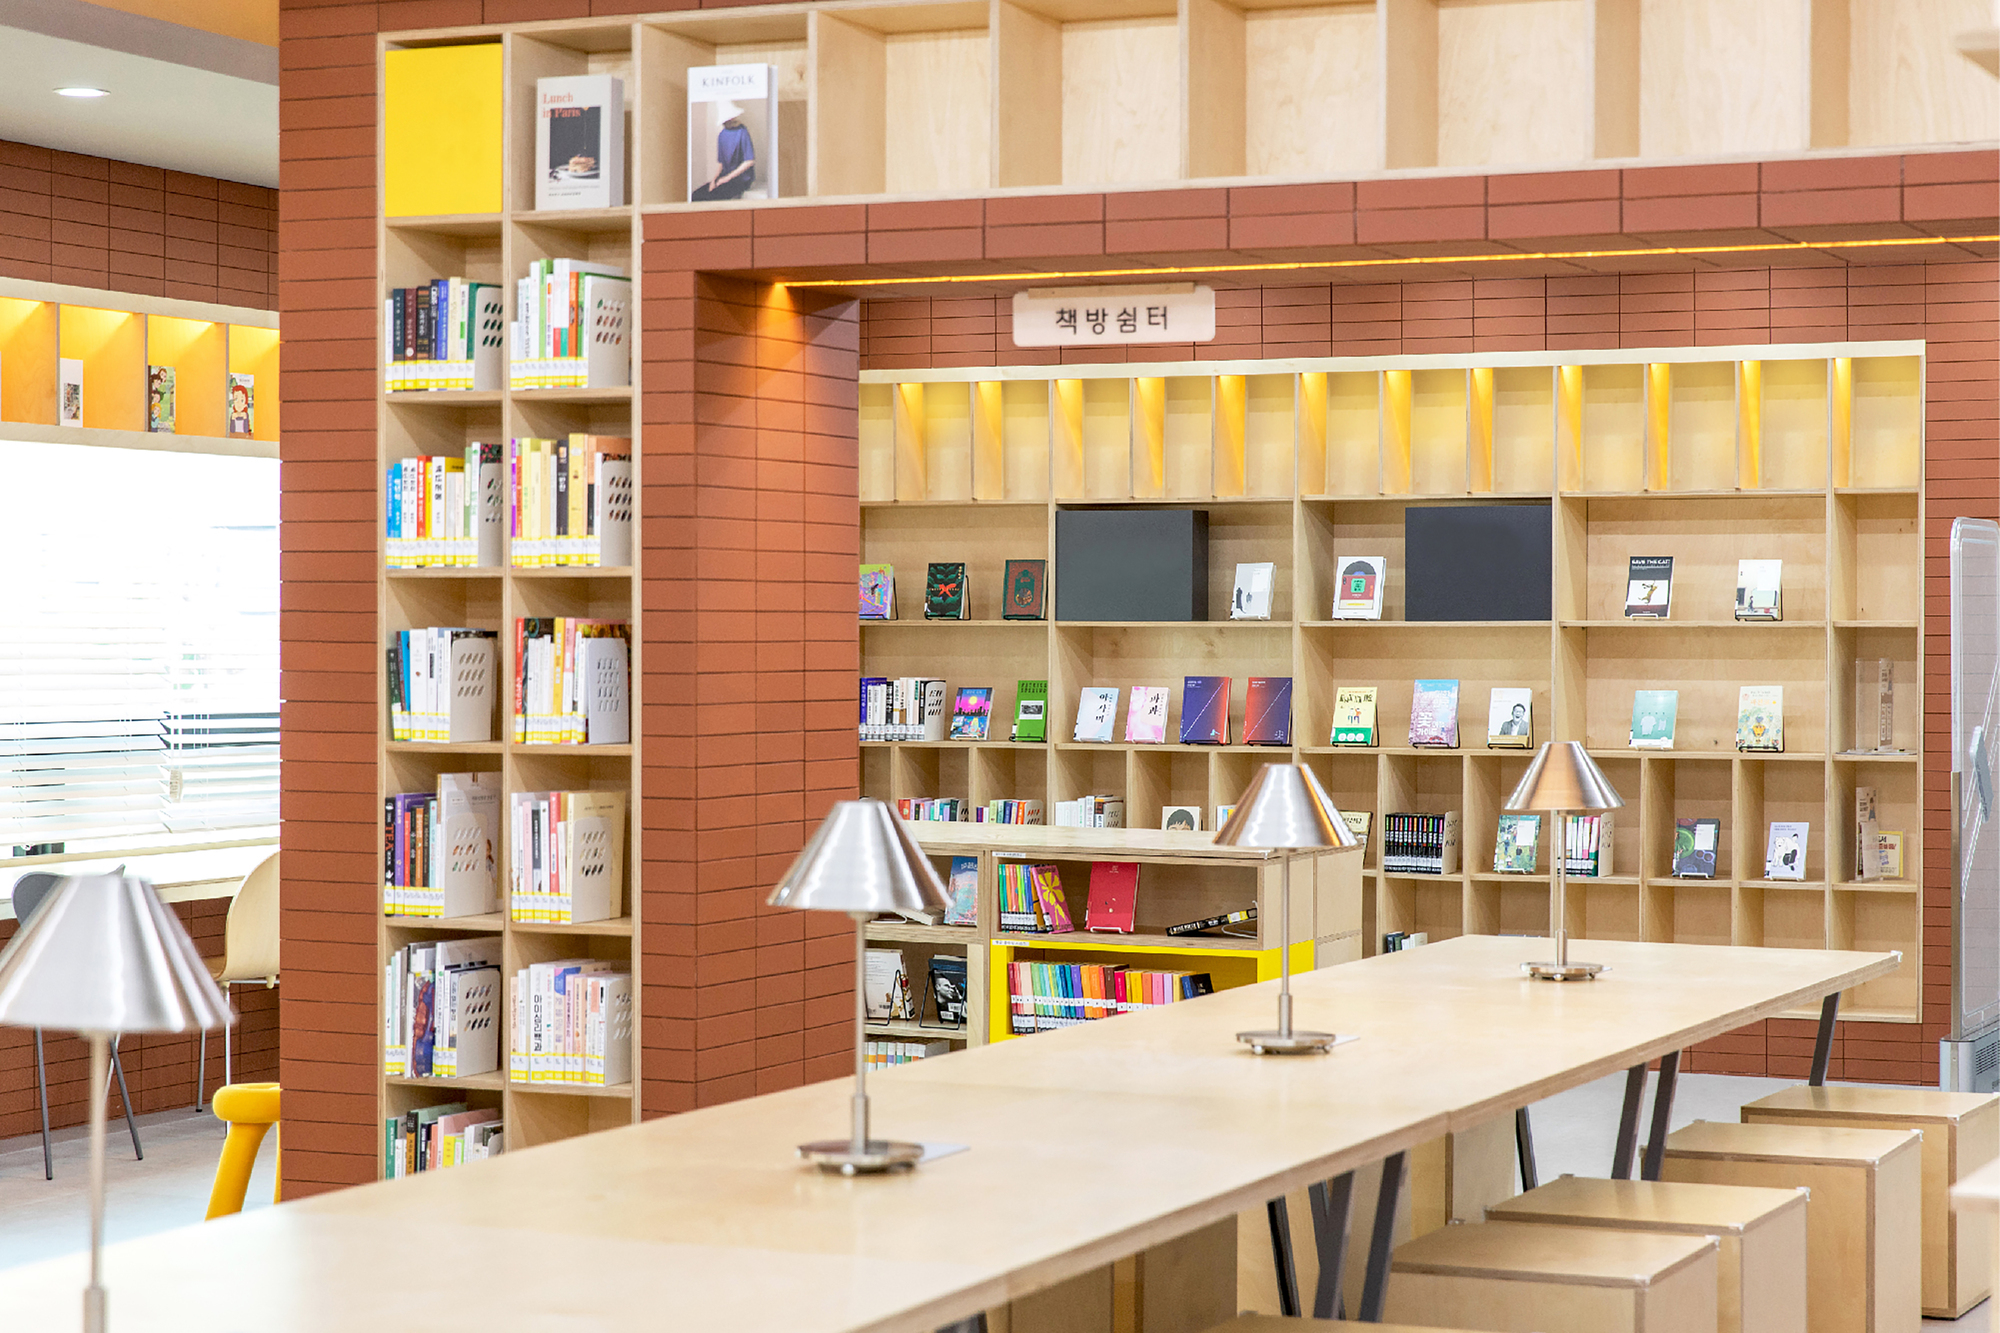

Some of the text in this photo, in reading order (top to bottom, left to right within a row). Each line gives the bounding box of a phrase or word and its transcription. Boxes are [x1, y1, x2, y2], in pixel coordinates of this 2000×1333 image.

[702, 75, 755, 88] KINFOLK
[543, 92, 574, 104] Lunch
[542, 107, 582, 118] in Paris
[1055, 306, 1168, 335] 책방쉼터
[385, 823, 394, 851] TEA
